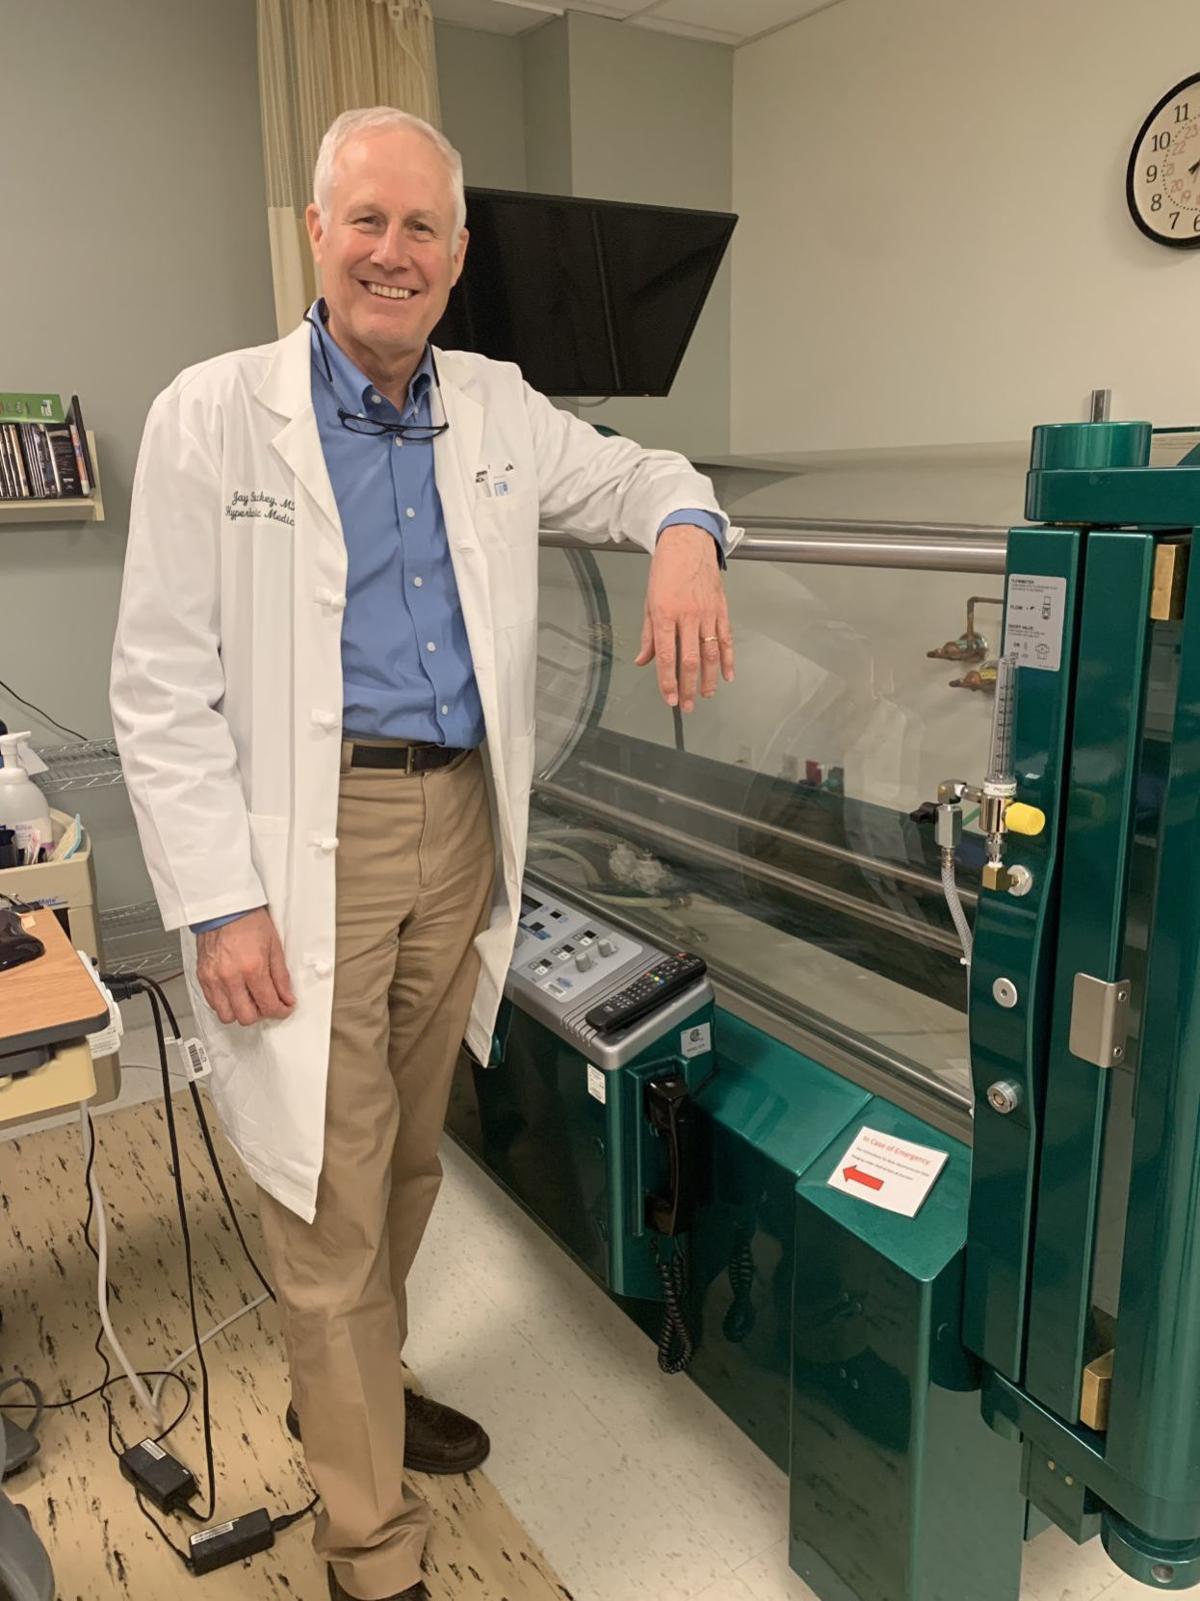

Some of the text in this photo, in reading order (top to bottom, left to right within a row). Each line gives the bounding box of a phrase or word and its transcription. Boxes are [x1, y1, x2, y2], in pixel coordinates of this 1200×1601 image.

[1174, 103, 1190, 124] 11
[1152, 131, 1171, 152] 10
[1146, 164, 1158, 184] 9
[1150, 193, 1162, 212] 8
[1169, 211, 1180, 230] 7
[232, 490, 249, 506] Jay
[870, 1138, 884, 1148] Case
[894, 1147, 931, 1166] Emergency
